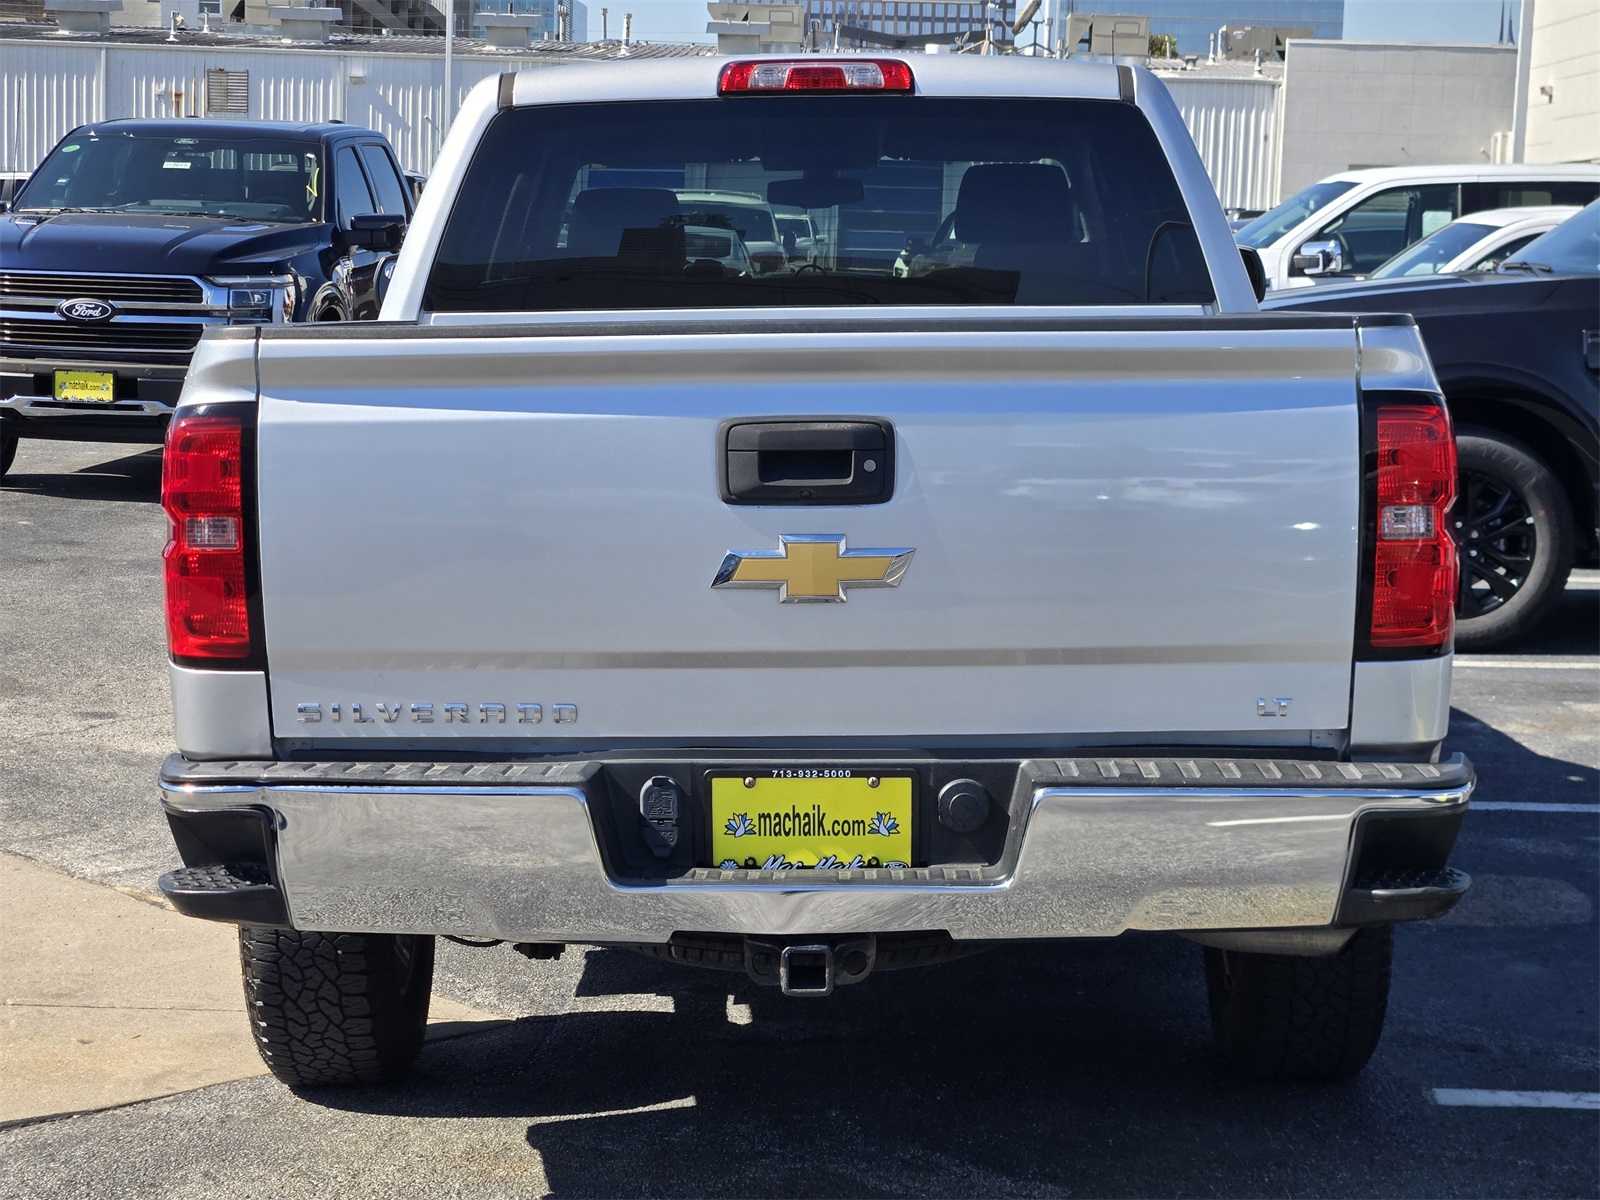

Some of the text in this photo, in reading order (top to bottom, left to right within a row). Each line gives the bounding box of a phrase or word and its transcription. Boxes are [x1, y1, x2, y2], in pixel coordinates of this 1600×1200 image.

[72, 303, 102, 317] Ford
[296, 702, 578, 725] SILVERADO
[1256, 697, 1295, 717] LT
[771, 769, 852, 778] 713-932-5000
[757, 804, 866, 837] machaik.com
